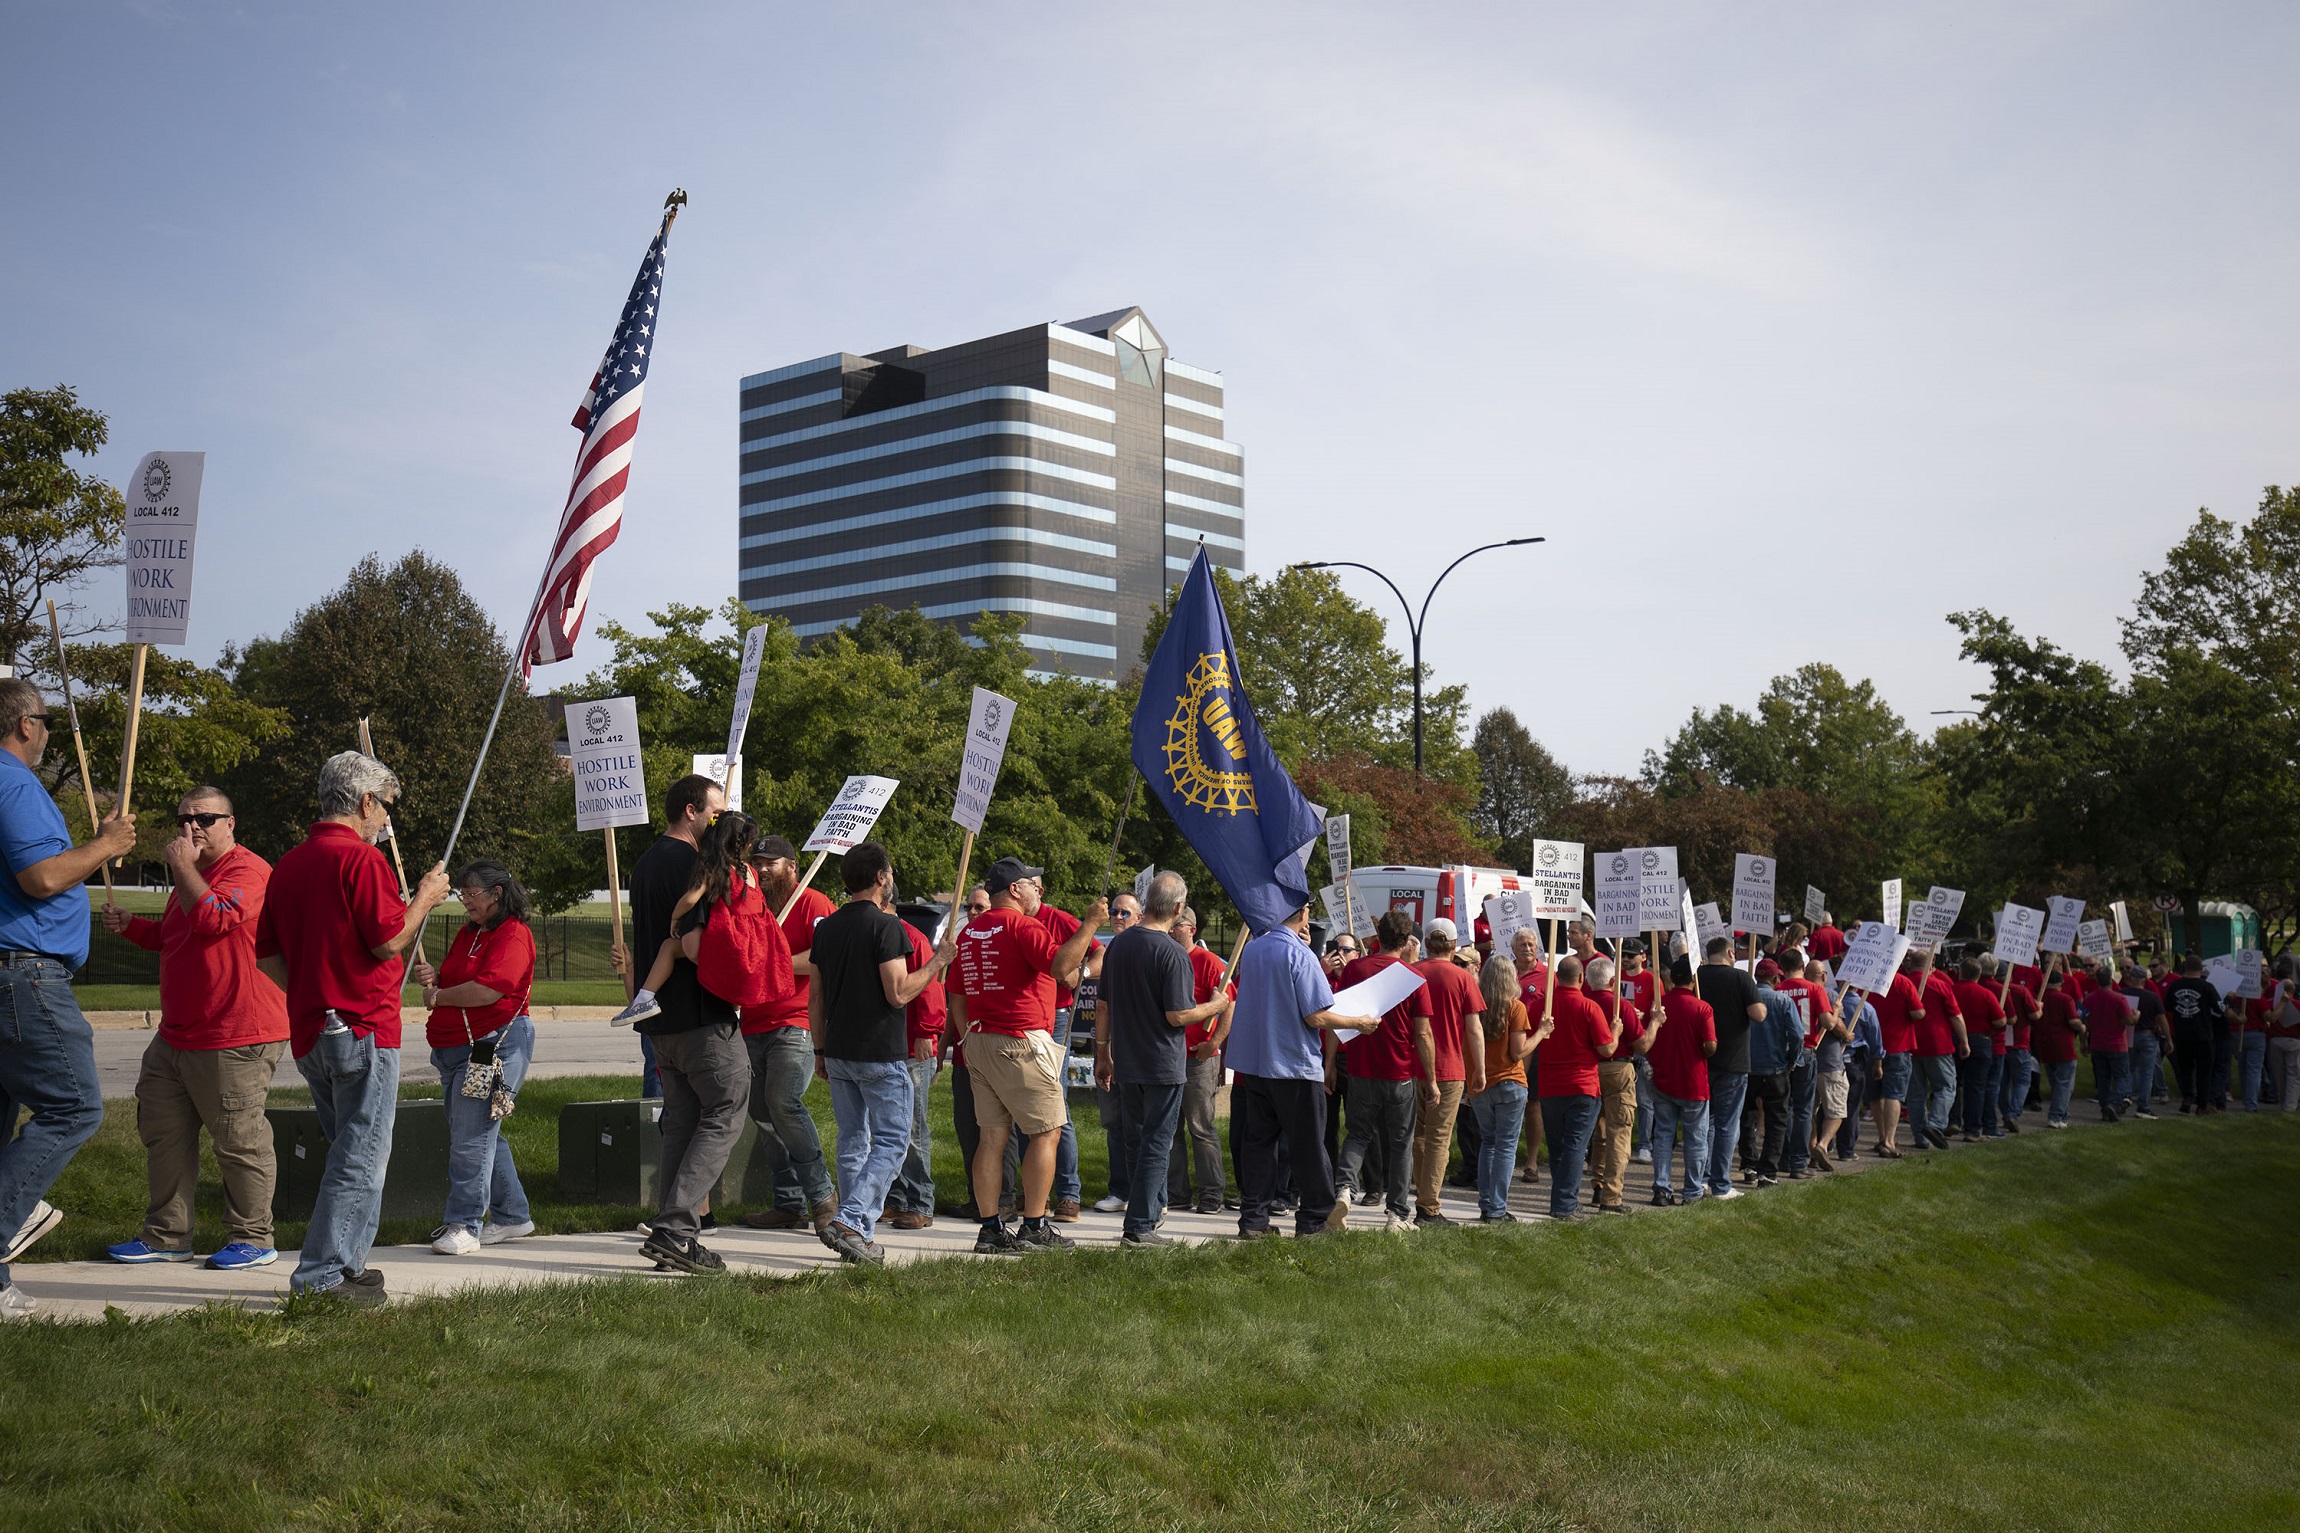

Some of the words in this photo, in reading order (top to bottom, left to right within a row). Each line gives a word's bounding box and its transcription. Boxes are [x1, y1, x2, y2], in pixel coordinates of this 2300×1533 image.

[134, 507, 159, 517] LOCAL
[161, 506, 180, 517] 412
[127, 539, 188, 560] HOSTILE
[129, 568, 175, 589] WORK
[1189, 693, 1199, 741] AUTOMOBILE
[1203, 696, 1248, 760] UAW
[580, 737, 604, 746] LOCAL
[606, 735, 623, 743] 412
[975, 728, 991, 742] LOCAL
[992, 736, 1001, 746] 412
[1189, 743, 1197, 767] UNITED
[577, 755, 637, 775] HOSTILE
[966, 749, 998, 777] HOSTILE
[585, 775, 630, 793] WORK
[967, 771, 992, 797] WORK
[868, 787, 886, 797] 412
[579, 793, 643, 814] ENVIRONMENT
[830, 803, 879, 815] STELLANTIS
[824, 813, 873, 825] BARGAINING
[827, 820, 838, 828] IN
[838, 820, 856, 830] BAD
[824, 828, 851, 838] FAITH
[1564, 853, 1578, 862] 412
[1535, 869, 1581, 880] STELLANTIS
[1535, 879, 1580, 890] BARGAINING
[1642, 884, 1675, 895] OSTILE
[1392, 890, 1422, 898] LOCAL
[1543, 888, 1552, 896] IN
[1554, 889, 1569, 897] BAD
[1598, 889, 1640, 900] BARGAINING
[1544, 896, 1568, 905] FAITH
[1740, 899, 1750, 909] IN
[1753, 901, 1770, 912] BAD
[1603, 903, 1614, 912] IN
[1617, 902, 1636, 912] BAD
[1605, 915, 1633, 925] FAITH
[1642, 910, 1678, 920] IRONMENT
[1742, 912, 1768, 924] FAITH
[1077, 1000, 1095, 1009] AIR
